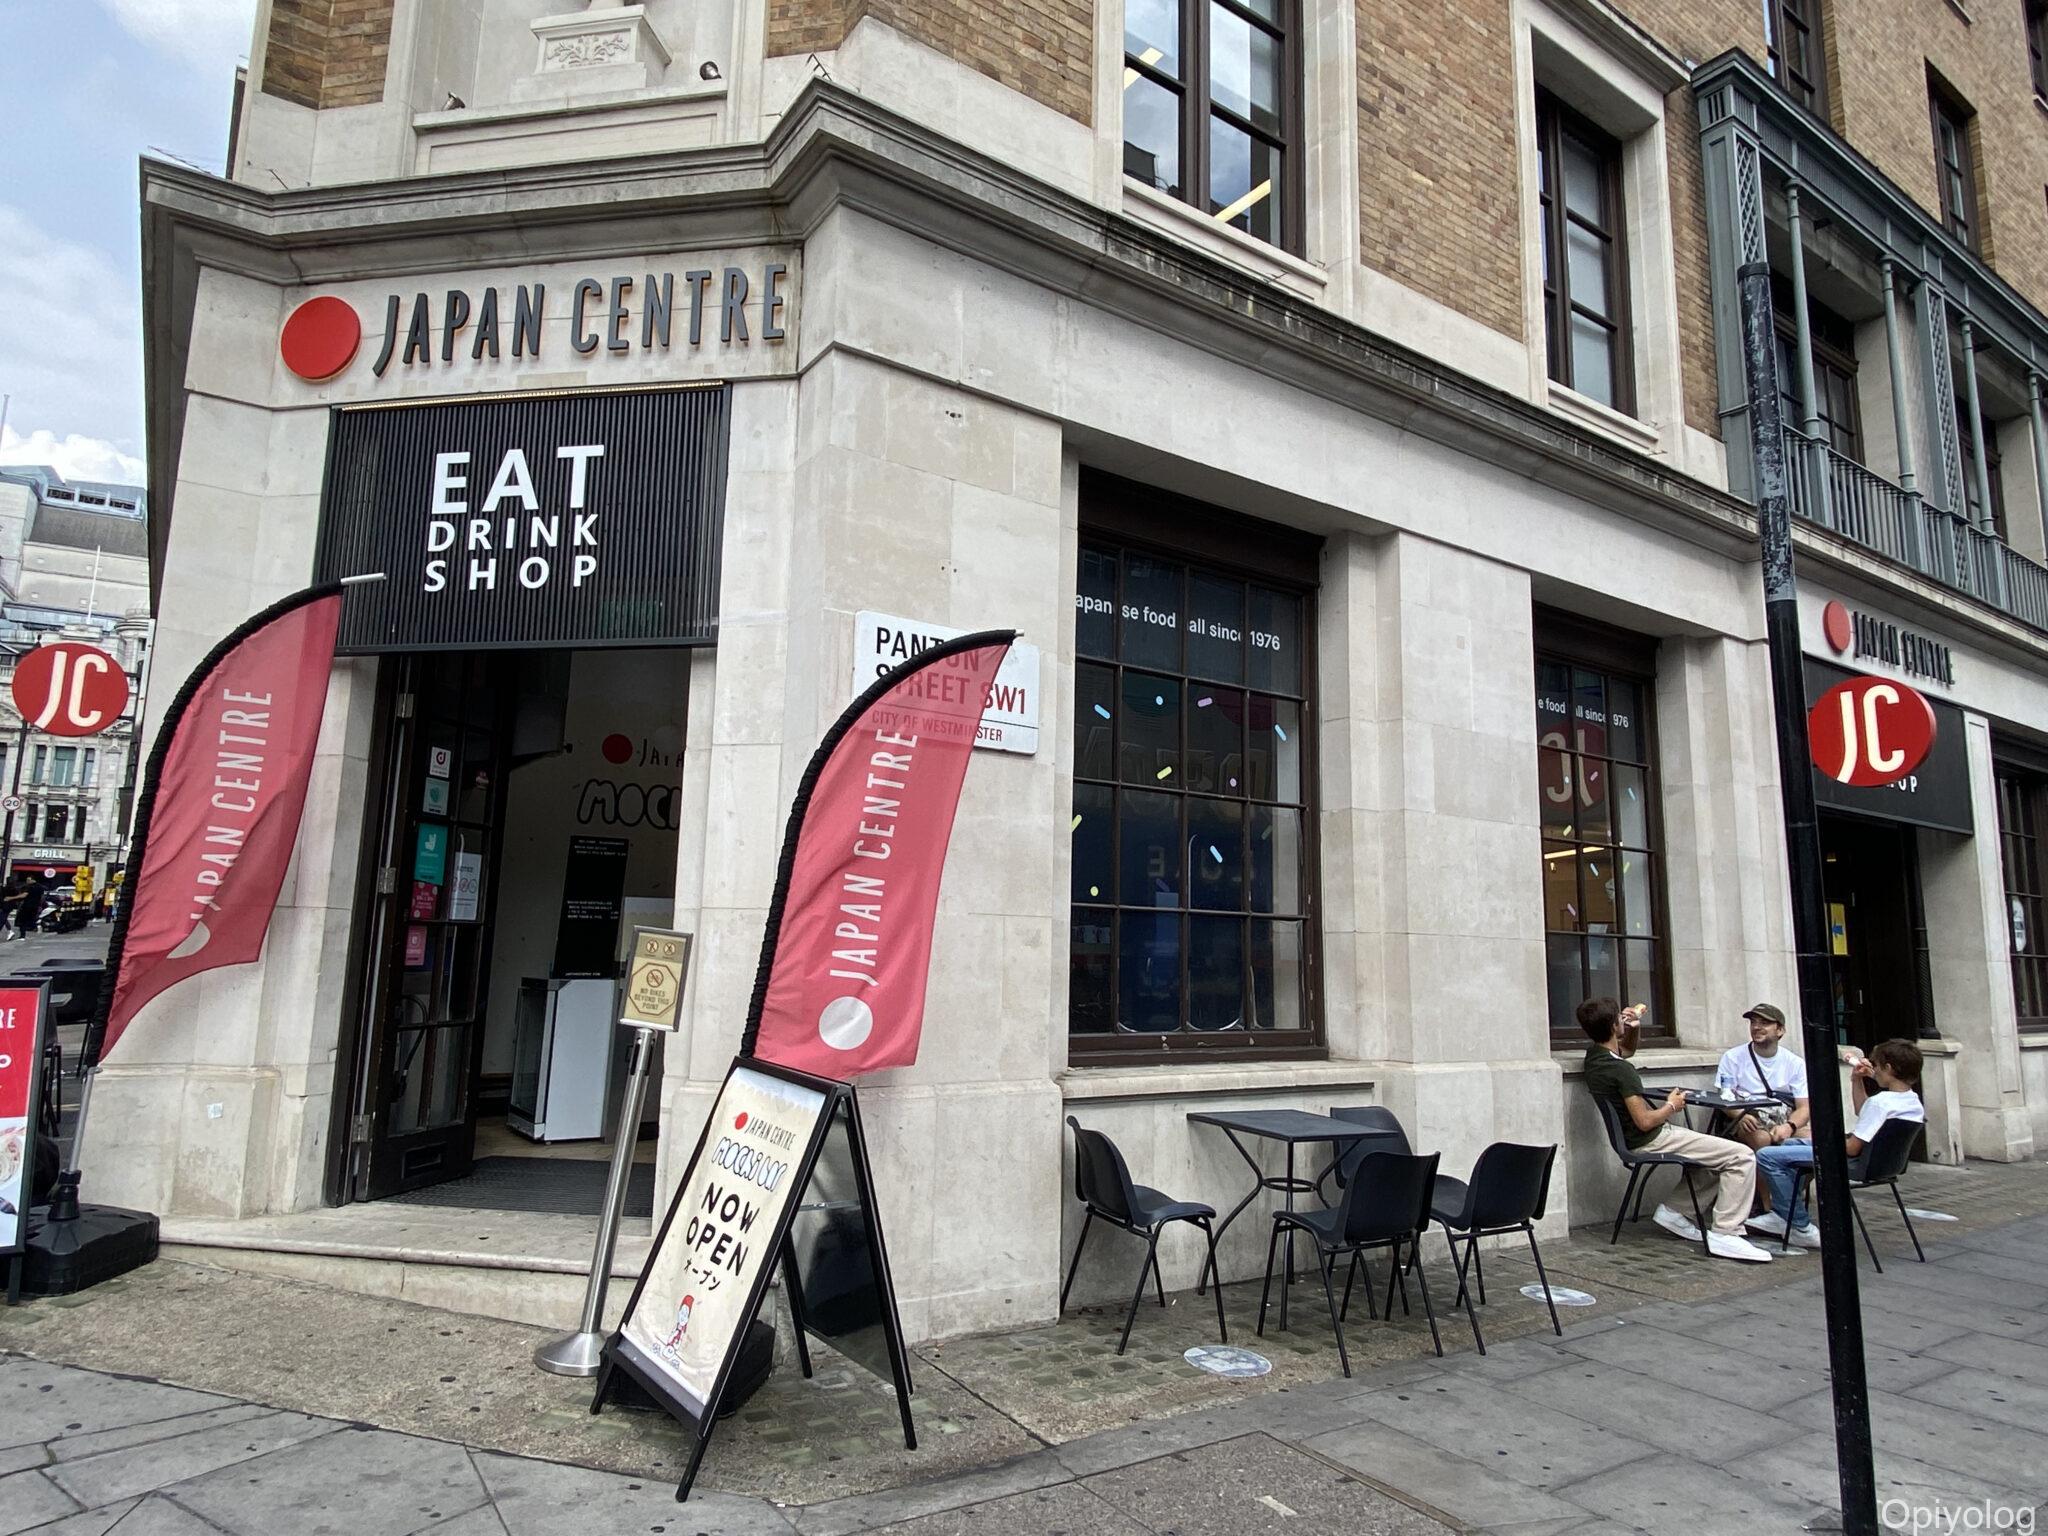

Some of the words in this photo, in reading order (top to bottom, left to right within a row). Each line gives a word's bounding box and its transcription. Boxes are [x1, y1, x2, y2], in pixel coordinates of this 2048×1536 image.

[372, 282, 546, 378] JAPAN
[570, 263, 787, 354] CENTRE
[430, 444, 605, 514] EAT
[427, 513, 599, 553] DRINK
[424, 553, 598, 593] SHOP
[1143, 606, 1176, 629] food
[1187, 618, 1205, 635] all
[1250, 630, 1281, 651] 1976
[33, 651, 108, 729] JC
[980, 681, 1026, 715] SW1
[1545, 697, 1566, 714] food
[1612, 715, 1629, 728] 976
[872, 709, 898, 726] CITY
[903, 714, 918, 730] OF
[923, 716, 1003, 742] WESTMINSTER
[1836, 684, 1905, 784] JC
[211, 688, 272, 813] CENTRE
[853, 727, 918, 860] CENTRE
[34, 849, 66, 859] GRILL
[829, 873, 886, 987] JAPAN
[744, 1116, 772, 1142] JAPAN
[768, 1126, 798, 1151] CENTRE
[701, 1181, 761, 1234] NOW
[686, 1216, 749, 1277] OPEN
[684, 1258, 721, 1291] オープン
